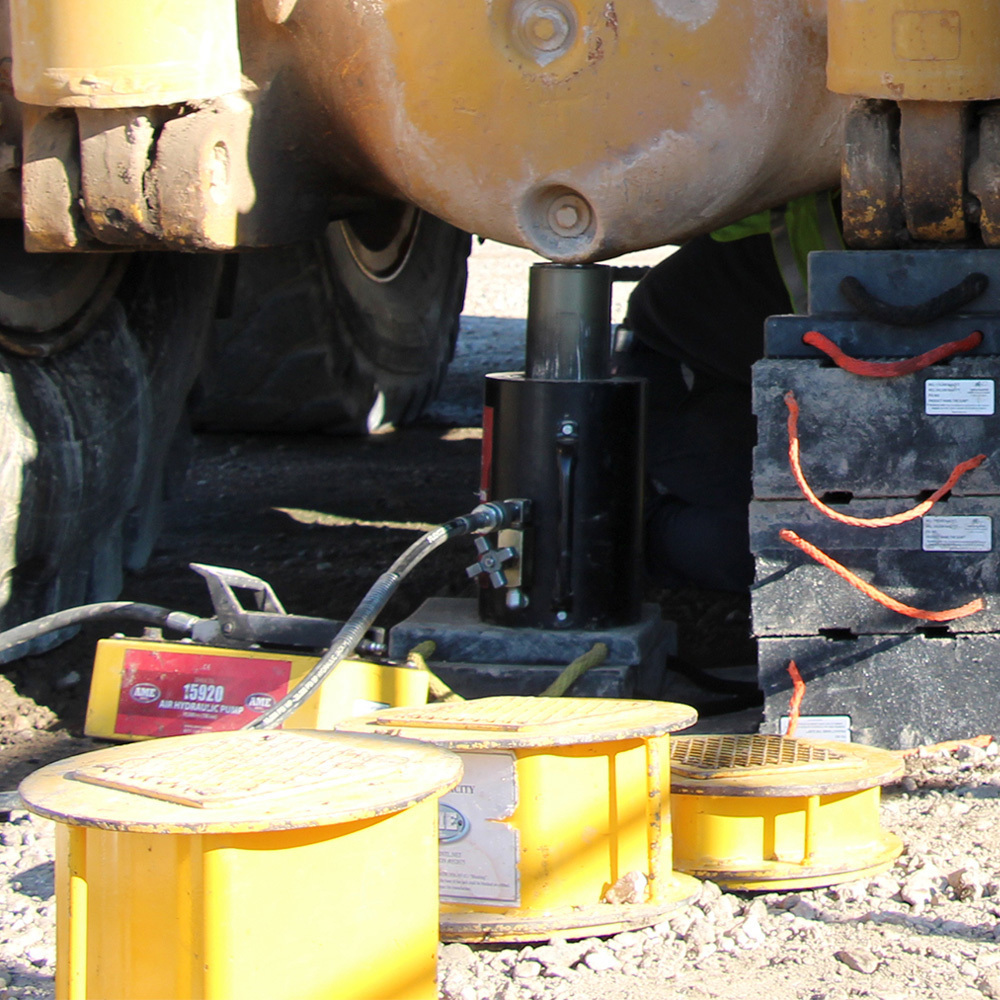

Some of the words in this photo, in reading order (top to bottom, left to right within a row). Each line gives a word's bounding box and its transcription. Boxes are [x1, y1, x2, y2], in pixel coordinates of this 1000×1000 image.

[134, 687, 156, 698] AME
[183, 683, 224, 703] 15920
[158, 699, 174, 709] AIR
[173, 701, 219, 713] HYDRAULIC
[219, 704, 244, 715] PUMP
[249, 697, 272, 707] AME
